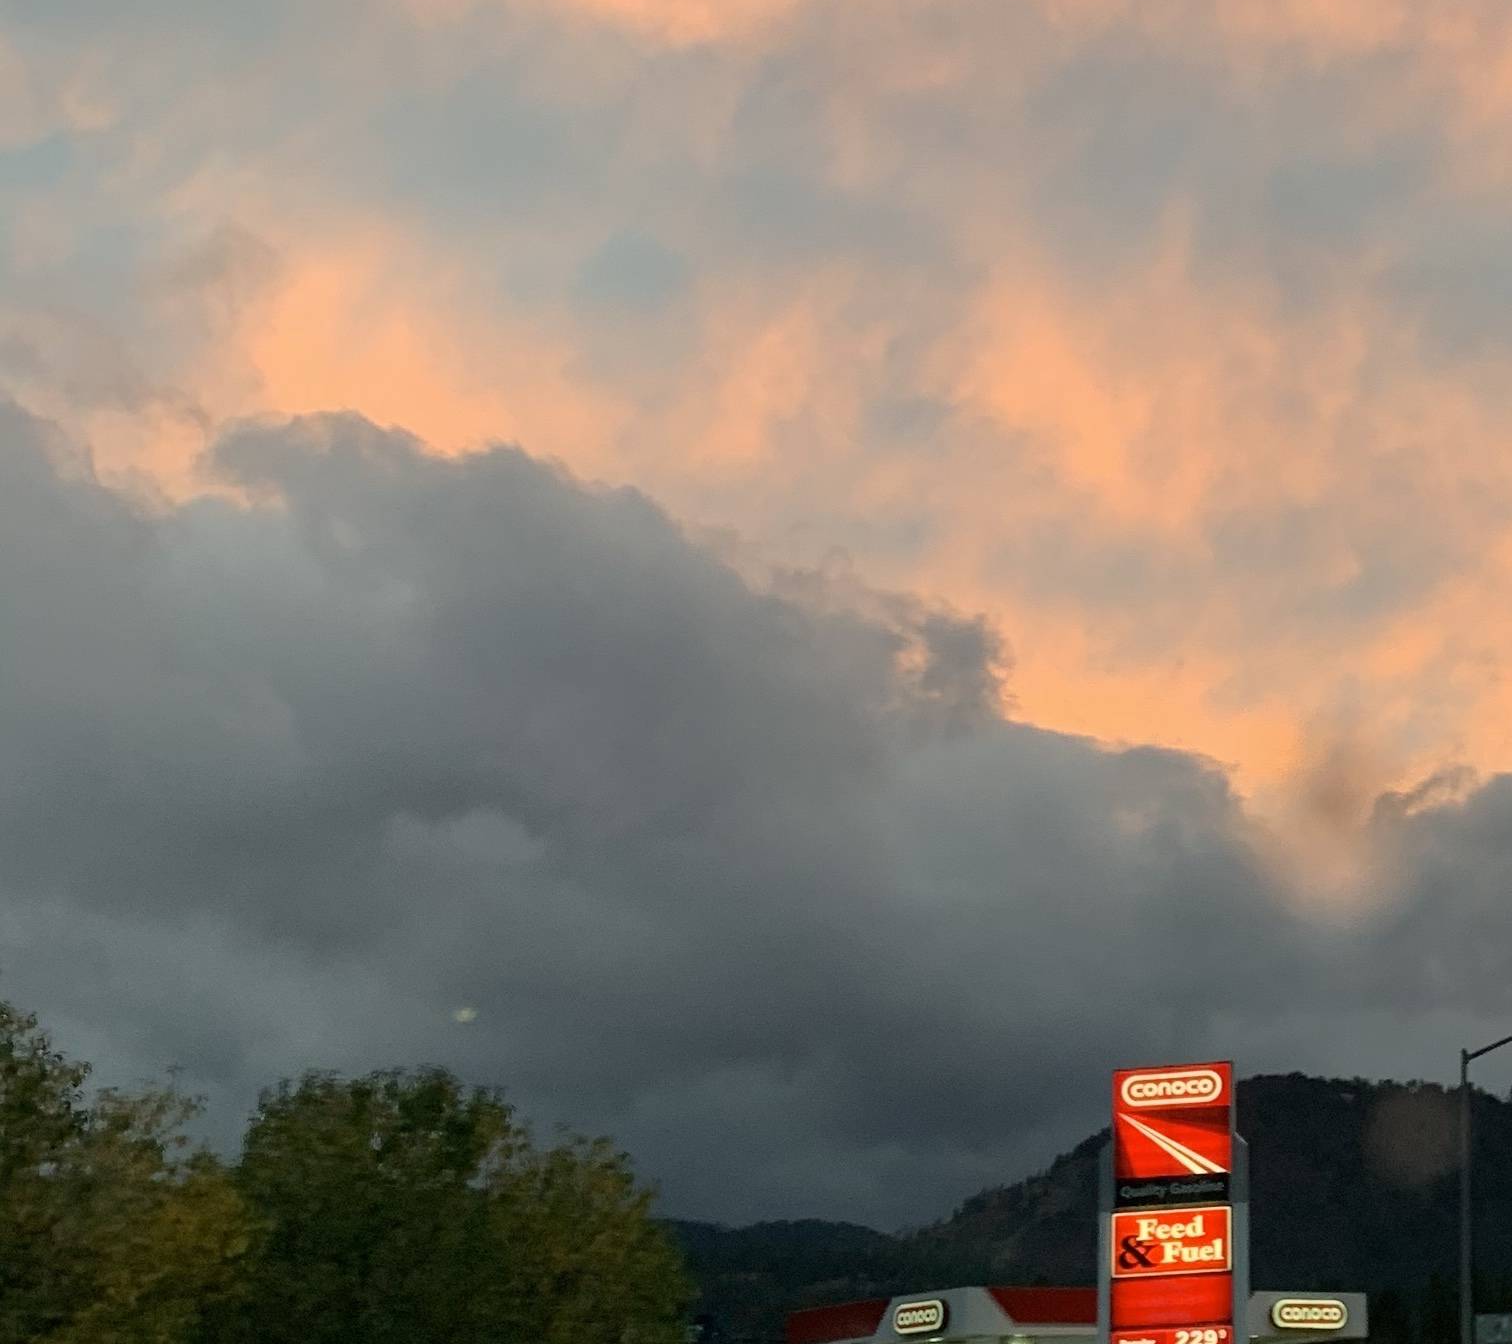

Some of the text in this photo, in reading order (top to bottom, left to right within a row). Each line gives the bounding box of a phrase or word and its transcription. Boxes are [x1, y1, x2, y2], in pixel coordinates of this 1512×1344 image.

[1136, 1215, 1206, 1241] Feed
[1119, 1235, 1159, 1269] &
[1161, 1238, 1225, 1264] Fuel
